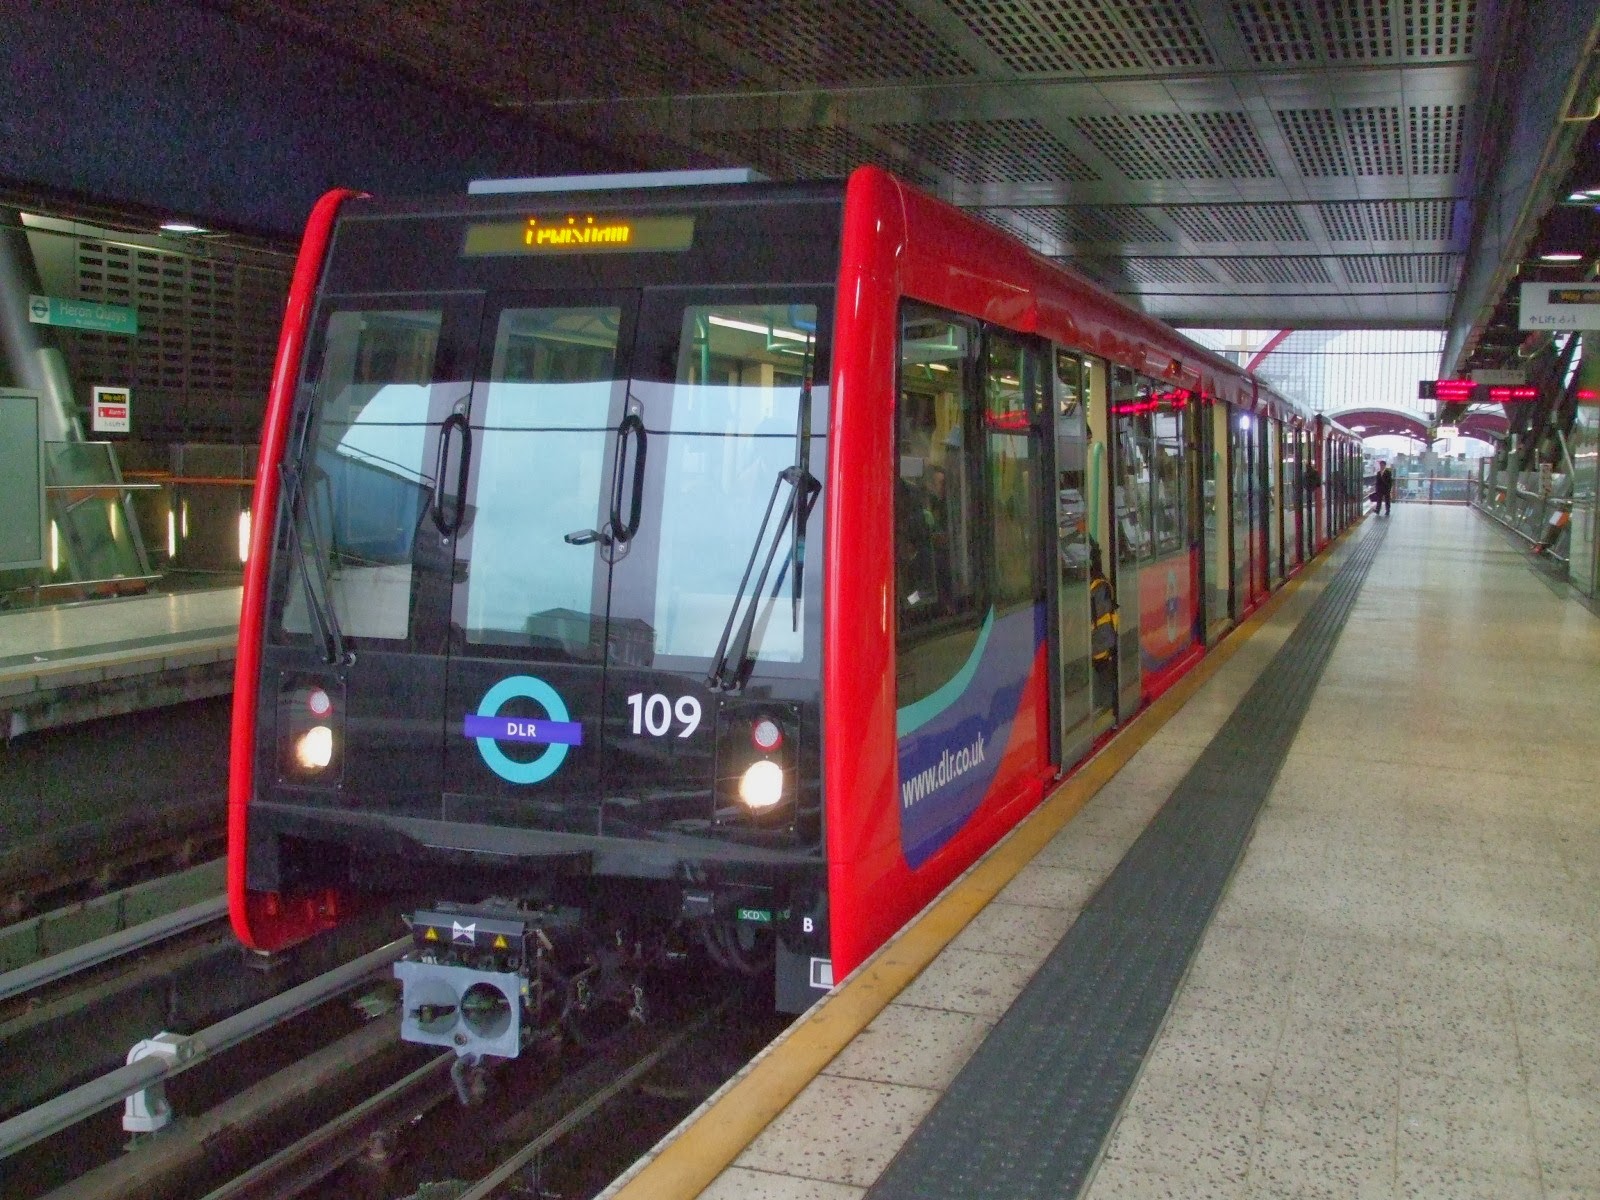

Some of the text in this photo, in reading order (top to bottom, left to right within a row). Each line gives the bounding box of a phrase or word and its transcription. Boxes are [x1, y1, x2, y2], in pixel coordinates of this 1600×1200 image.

[59, 302, 127, 323] Heron Quays
[1538, 315, 1556, 324] Lift
[627, 692, 702, 738] 109
[507, 722, 537, 738] DLR
[902, 731, 985, 809] www.dlr.co.uk
[803, 917, 814, 933] B
